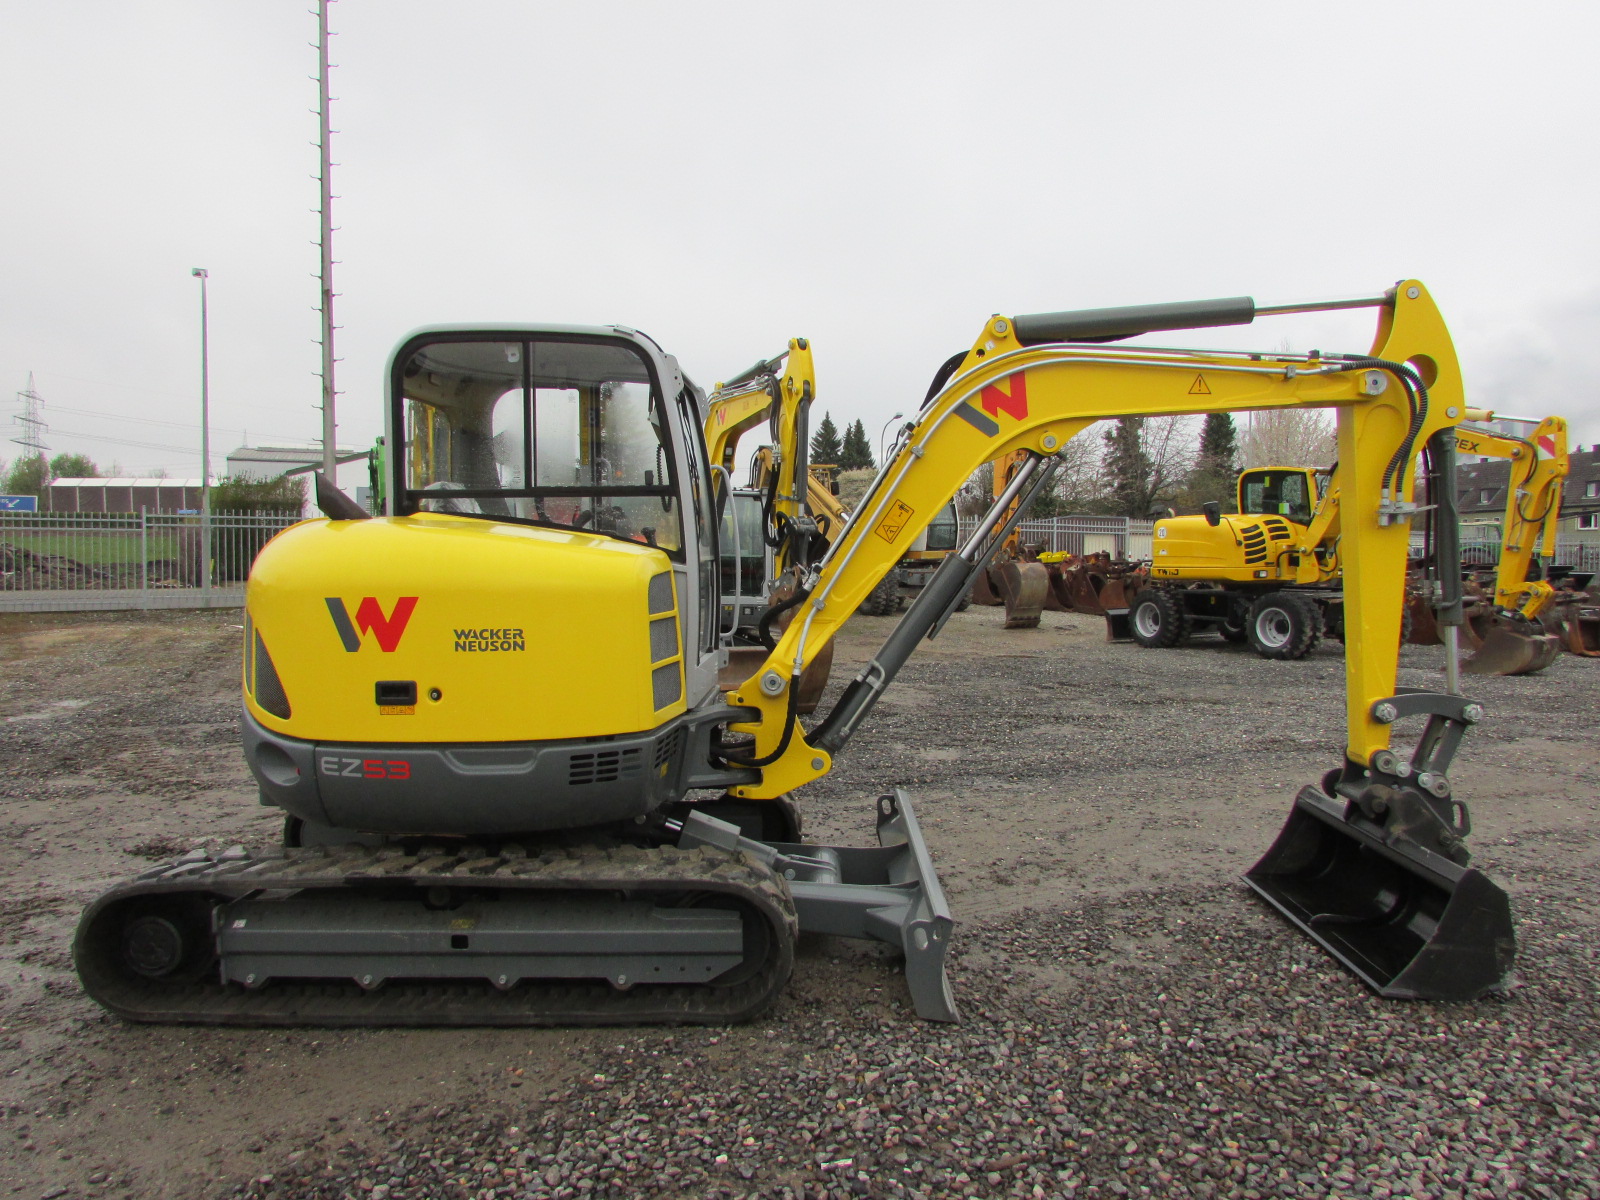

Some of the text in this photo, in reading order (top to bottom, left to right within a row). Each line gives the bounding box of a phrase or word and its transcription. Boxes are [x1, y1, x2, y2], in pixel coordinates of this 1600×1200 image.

[324, 596, 419, 652] W
[453, 628, 524, 640] WACKER
[454, 640, 526, 652] NEUSON
[320, 756, 411, 779] EZ53
